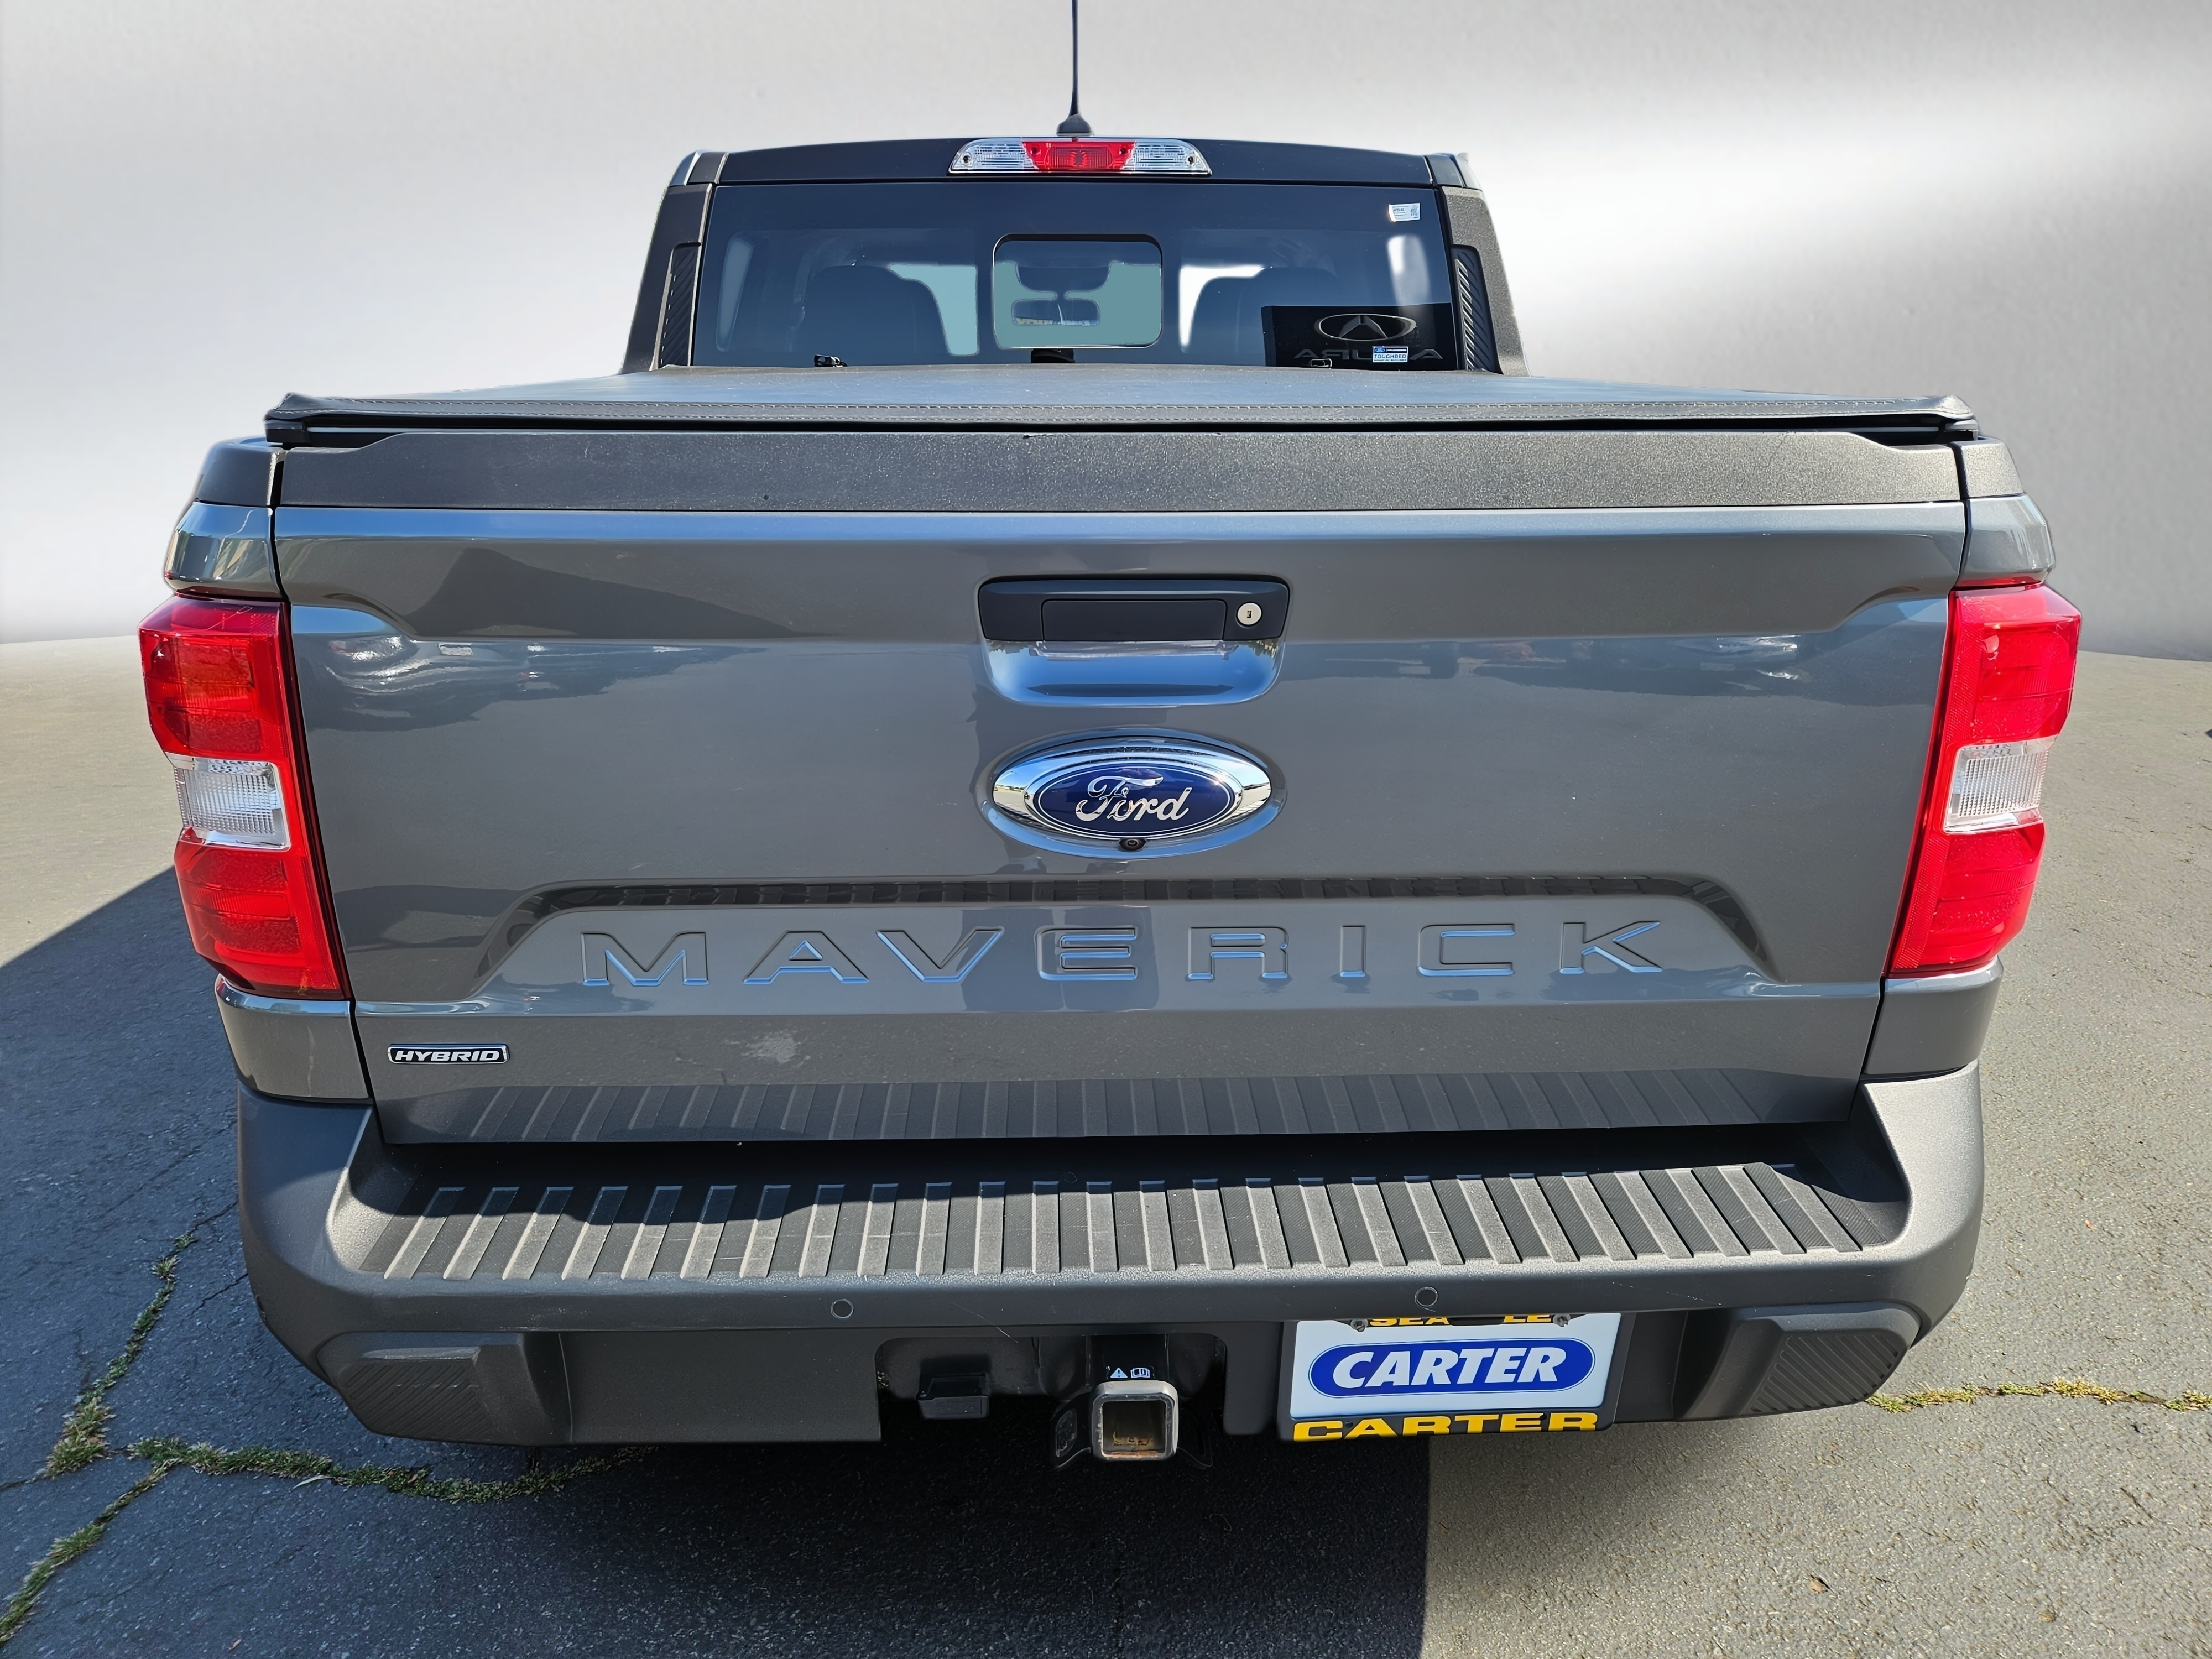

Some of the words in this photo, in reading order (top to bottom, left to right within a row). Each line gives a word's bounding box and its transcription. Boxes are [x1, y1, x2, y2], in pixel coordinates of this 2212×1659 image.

[1075, 775, 1193, 822] Ford
[580, 921, 1663, 987] MAVERICK
[394, 1051, 500, 1062] HYBRID
[1333, 1347, 1567, 1389] CARTER
[1293, 1412, 1599, 1442] CARTER
